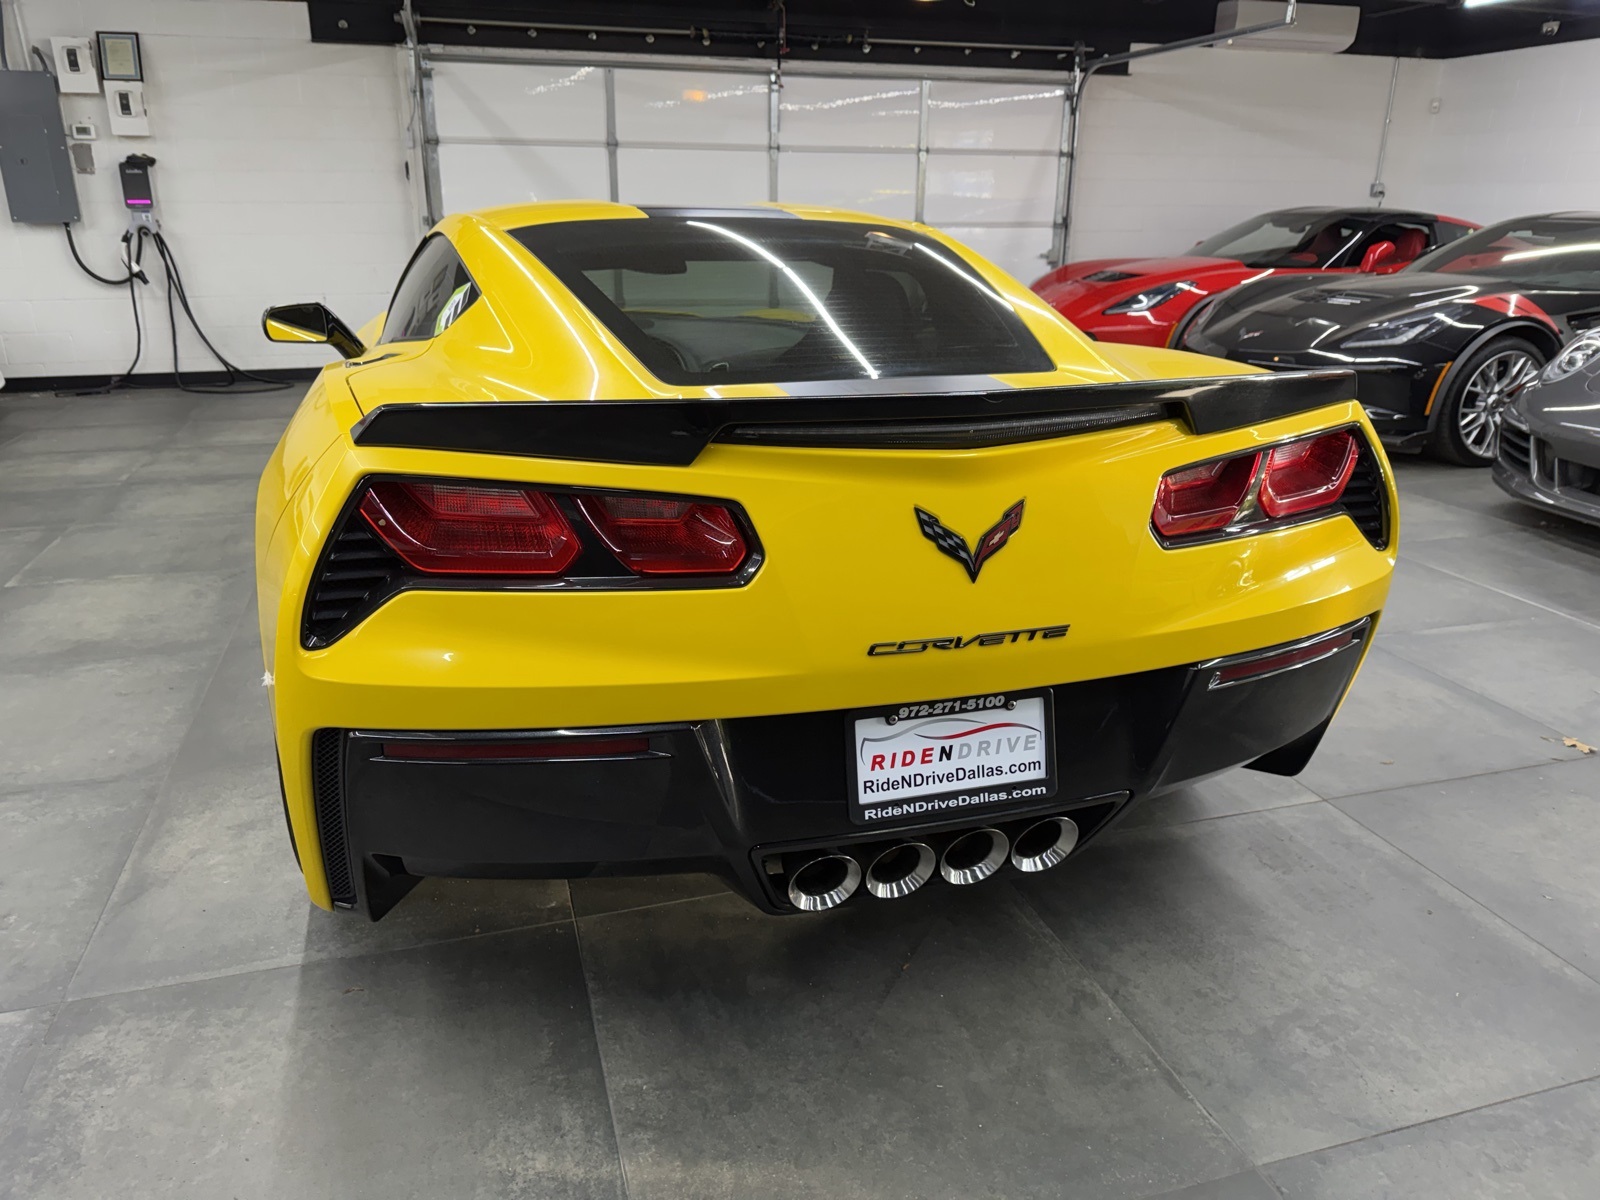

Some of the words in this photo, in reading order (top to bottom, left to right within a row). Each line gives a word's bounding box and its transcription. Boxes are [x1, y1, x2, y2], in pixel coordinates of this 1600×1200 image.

[867, 624, 1071, 656] CORVETTE
[898, 695, 1005, 719] 972-271-5100
[863, 759, 1042, 795] RideNDriveDallas.com
[864, 786, 1047, 820] RideNDriveDallas.com
